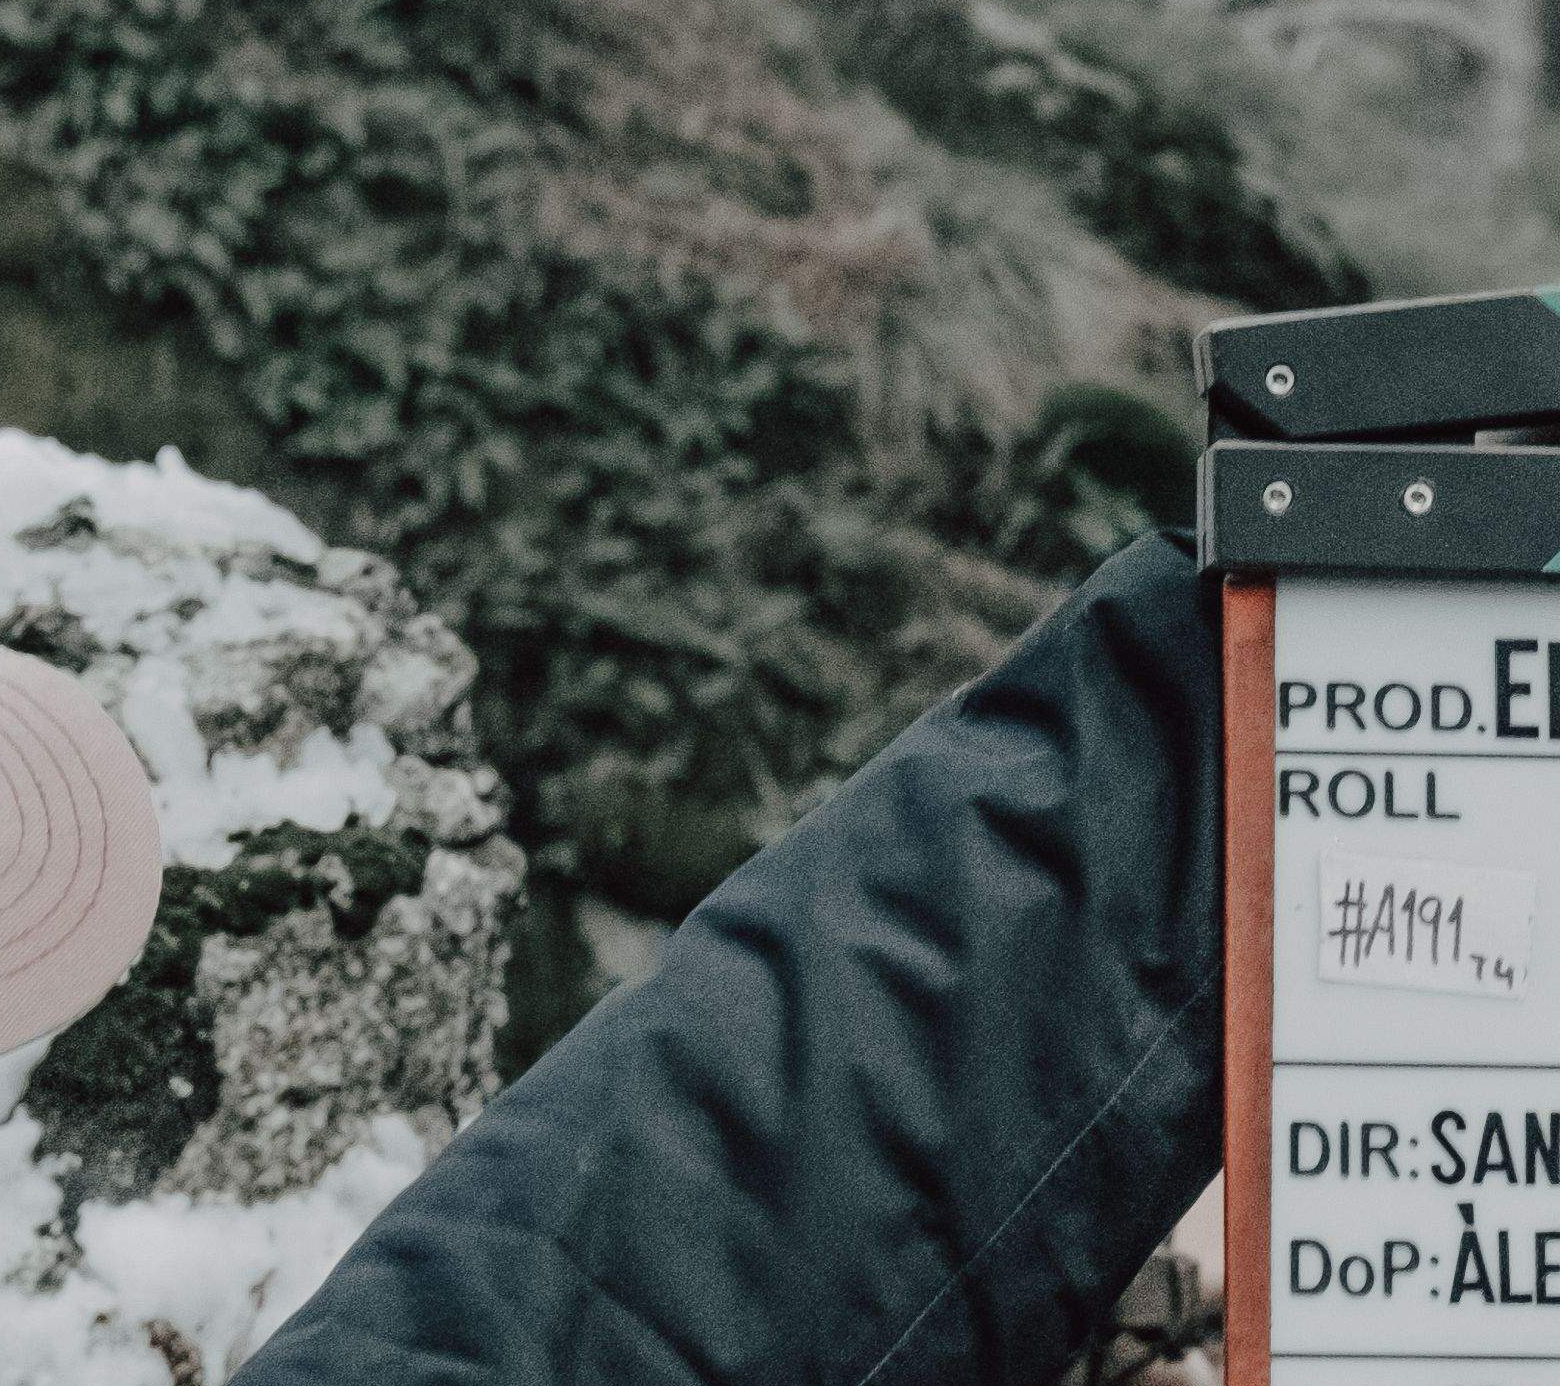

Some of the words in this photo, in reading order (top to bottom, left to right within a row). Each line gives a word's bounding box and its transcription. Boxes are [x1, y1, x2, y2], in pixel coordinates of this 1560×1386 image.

[1277, 680, 1488, 733] PROD.
[1278, 769, 1462, 820] ROLL
[1289, 1120, 1420, 1181] DIR:
[1289, 1236, 1440, 1299] DoP:
